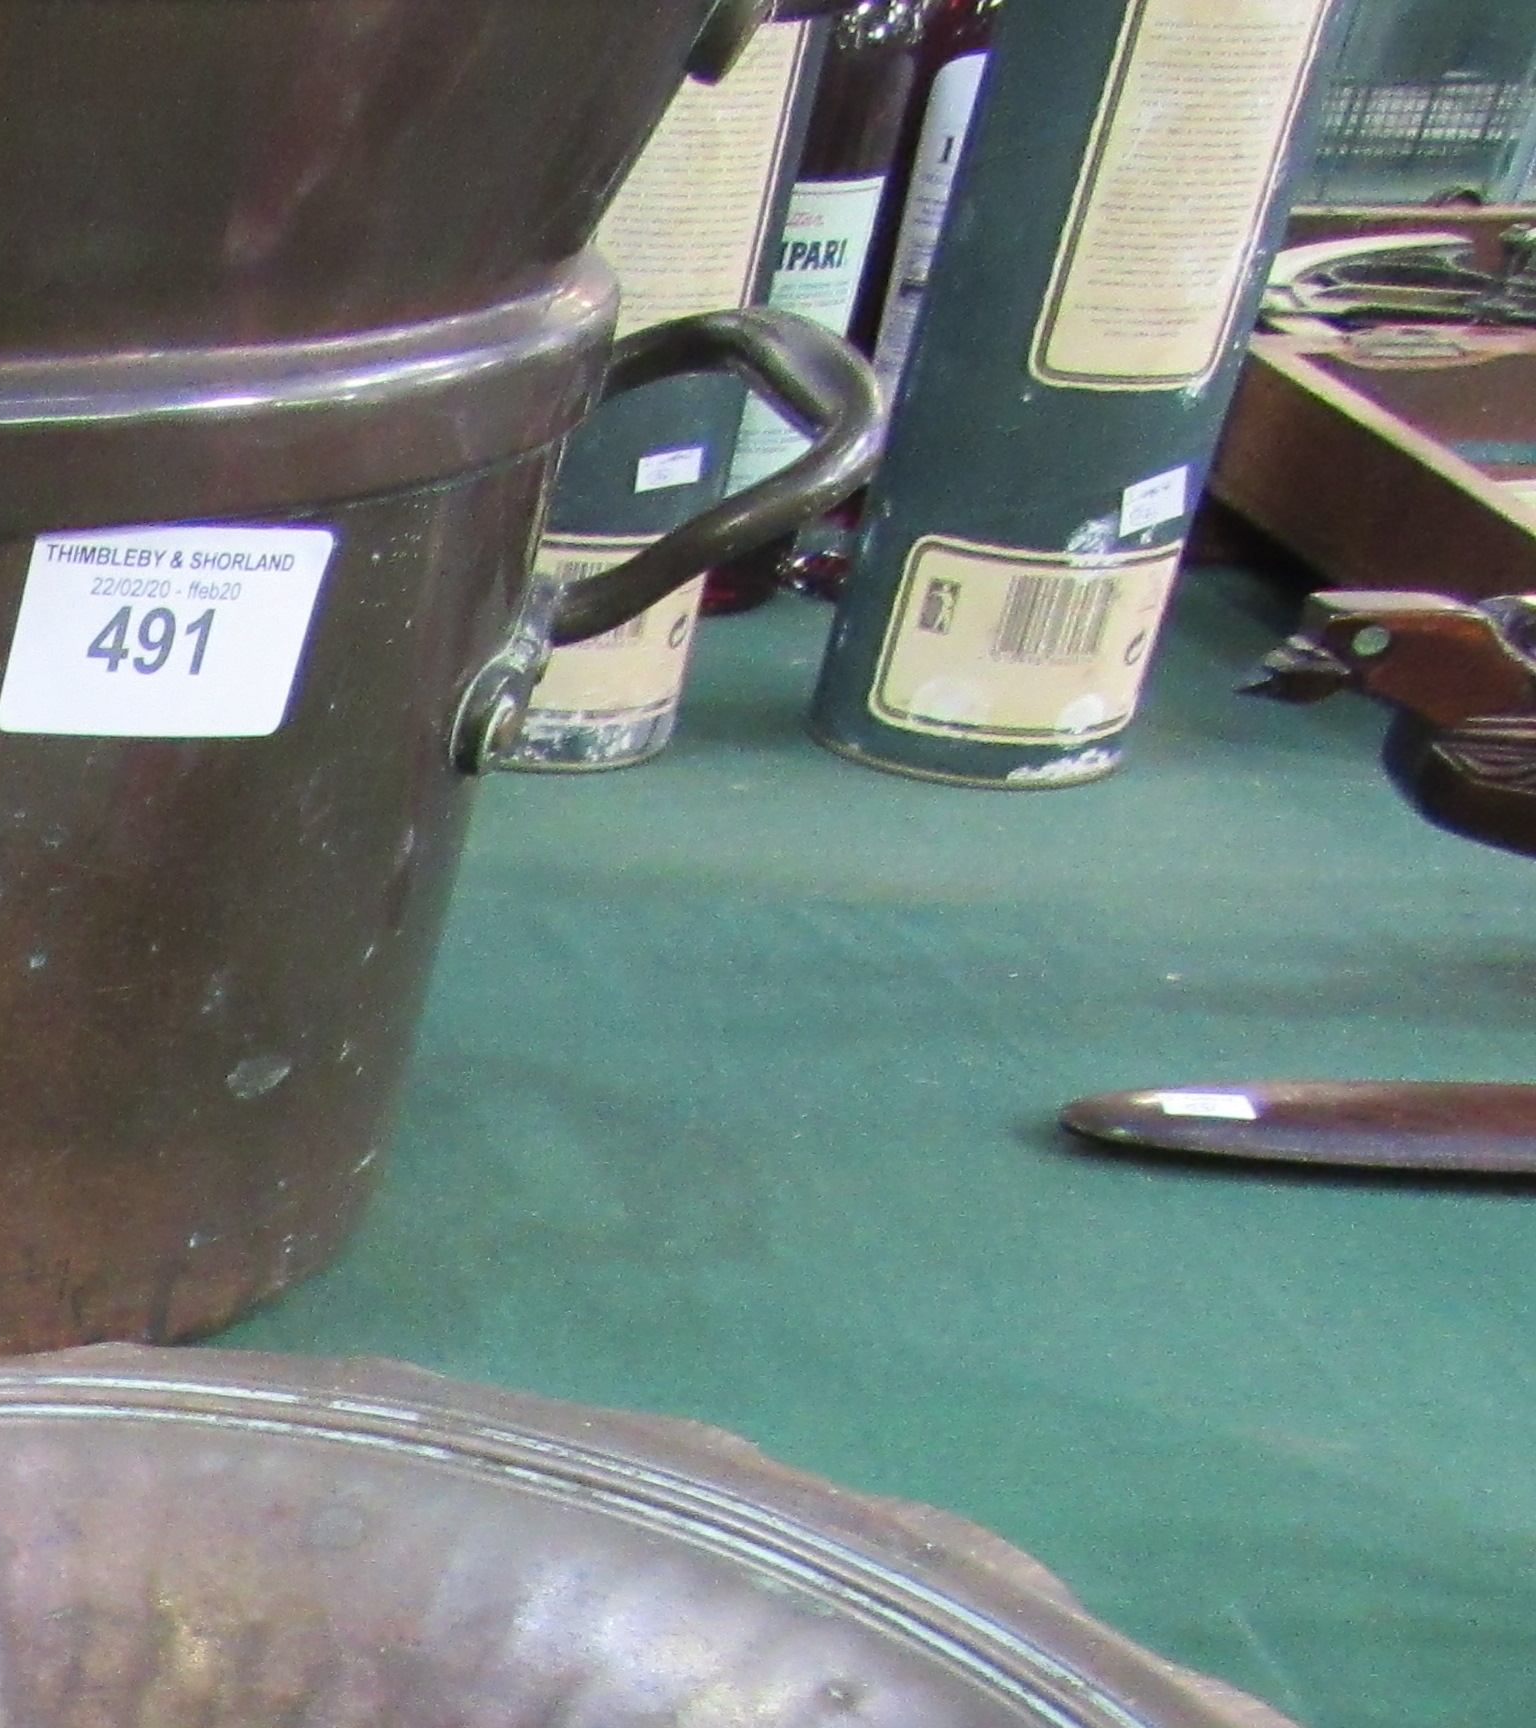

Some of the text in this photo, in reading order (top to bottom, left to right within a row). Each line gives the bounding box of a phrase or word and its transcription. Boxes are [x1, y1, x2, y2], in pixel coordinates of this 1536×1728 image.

[46, 543, 296, 571] THIMBLEBY & SHORLAND
[90, 577, 171, 598] 22/02/20
[188, 580, 242, 601] ffeb20
[86, 606, 216, 675] 491
